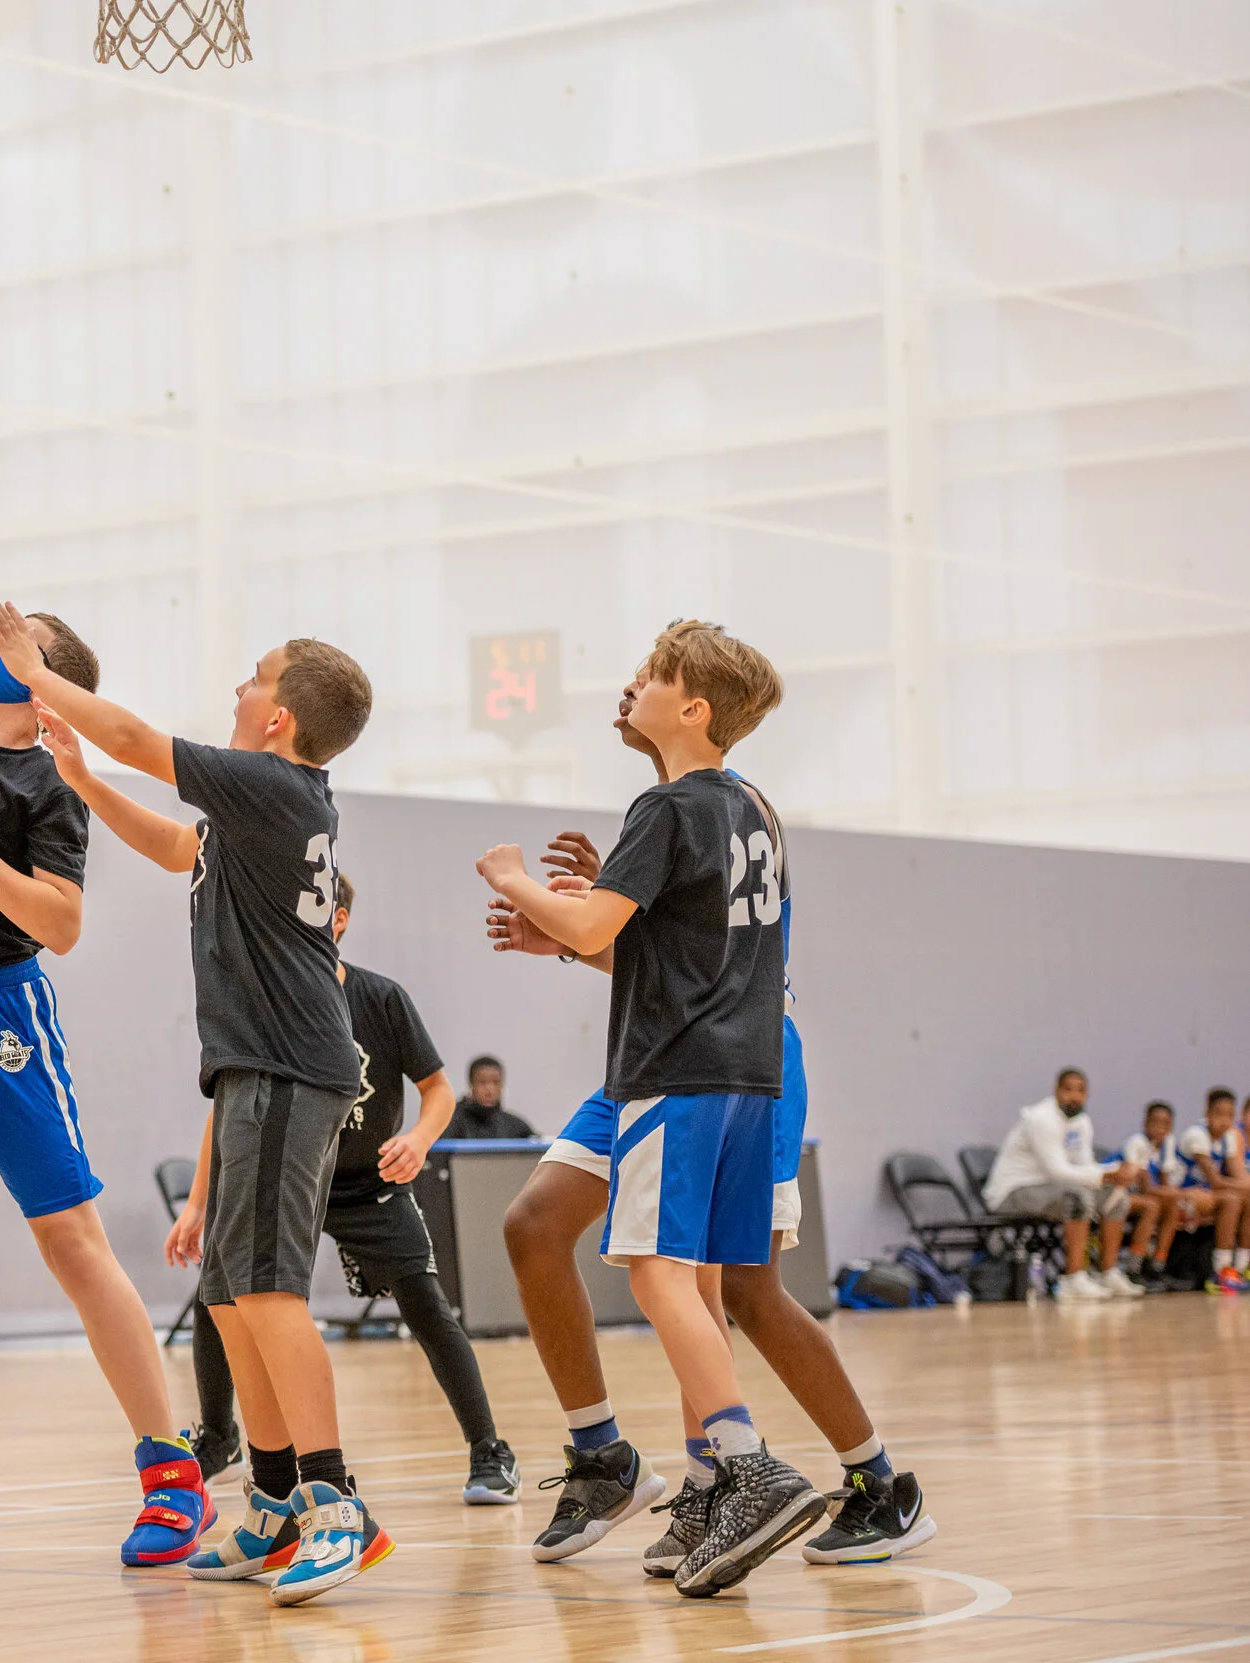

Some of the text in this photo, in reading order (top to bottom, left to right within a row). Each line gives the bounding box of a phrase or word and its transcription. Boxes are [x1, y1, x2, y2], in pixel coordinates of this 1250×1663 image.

[485, 668, 537, 719] 24
[296, 833, 338, 928] 3
[729, 830, 781, 928] 23
